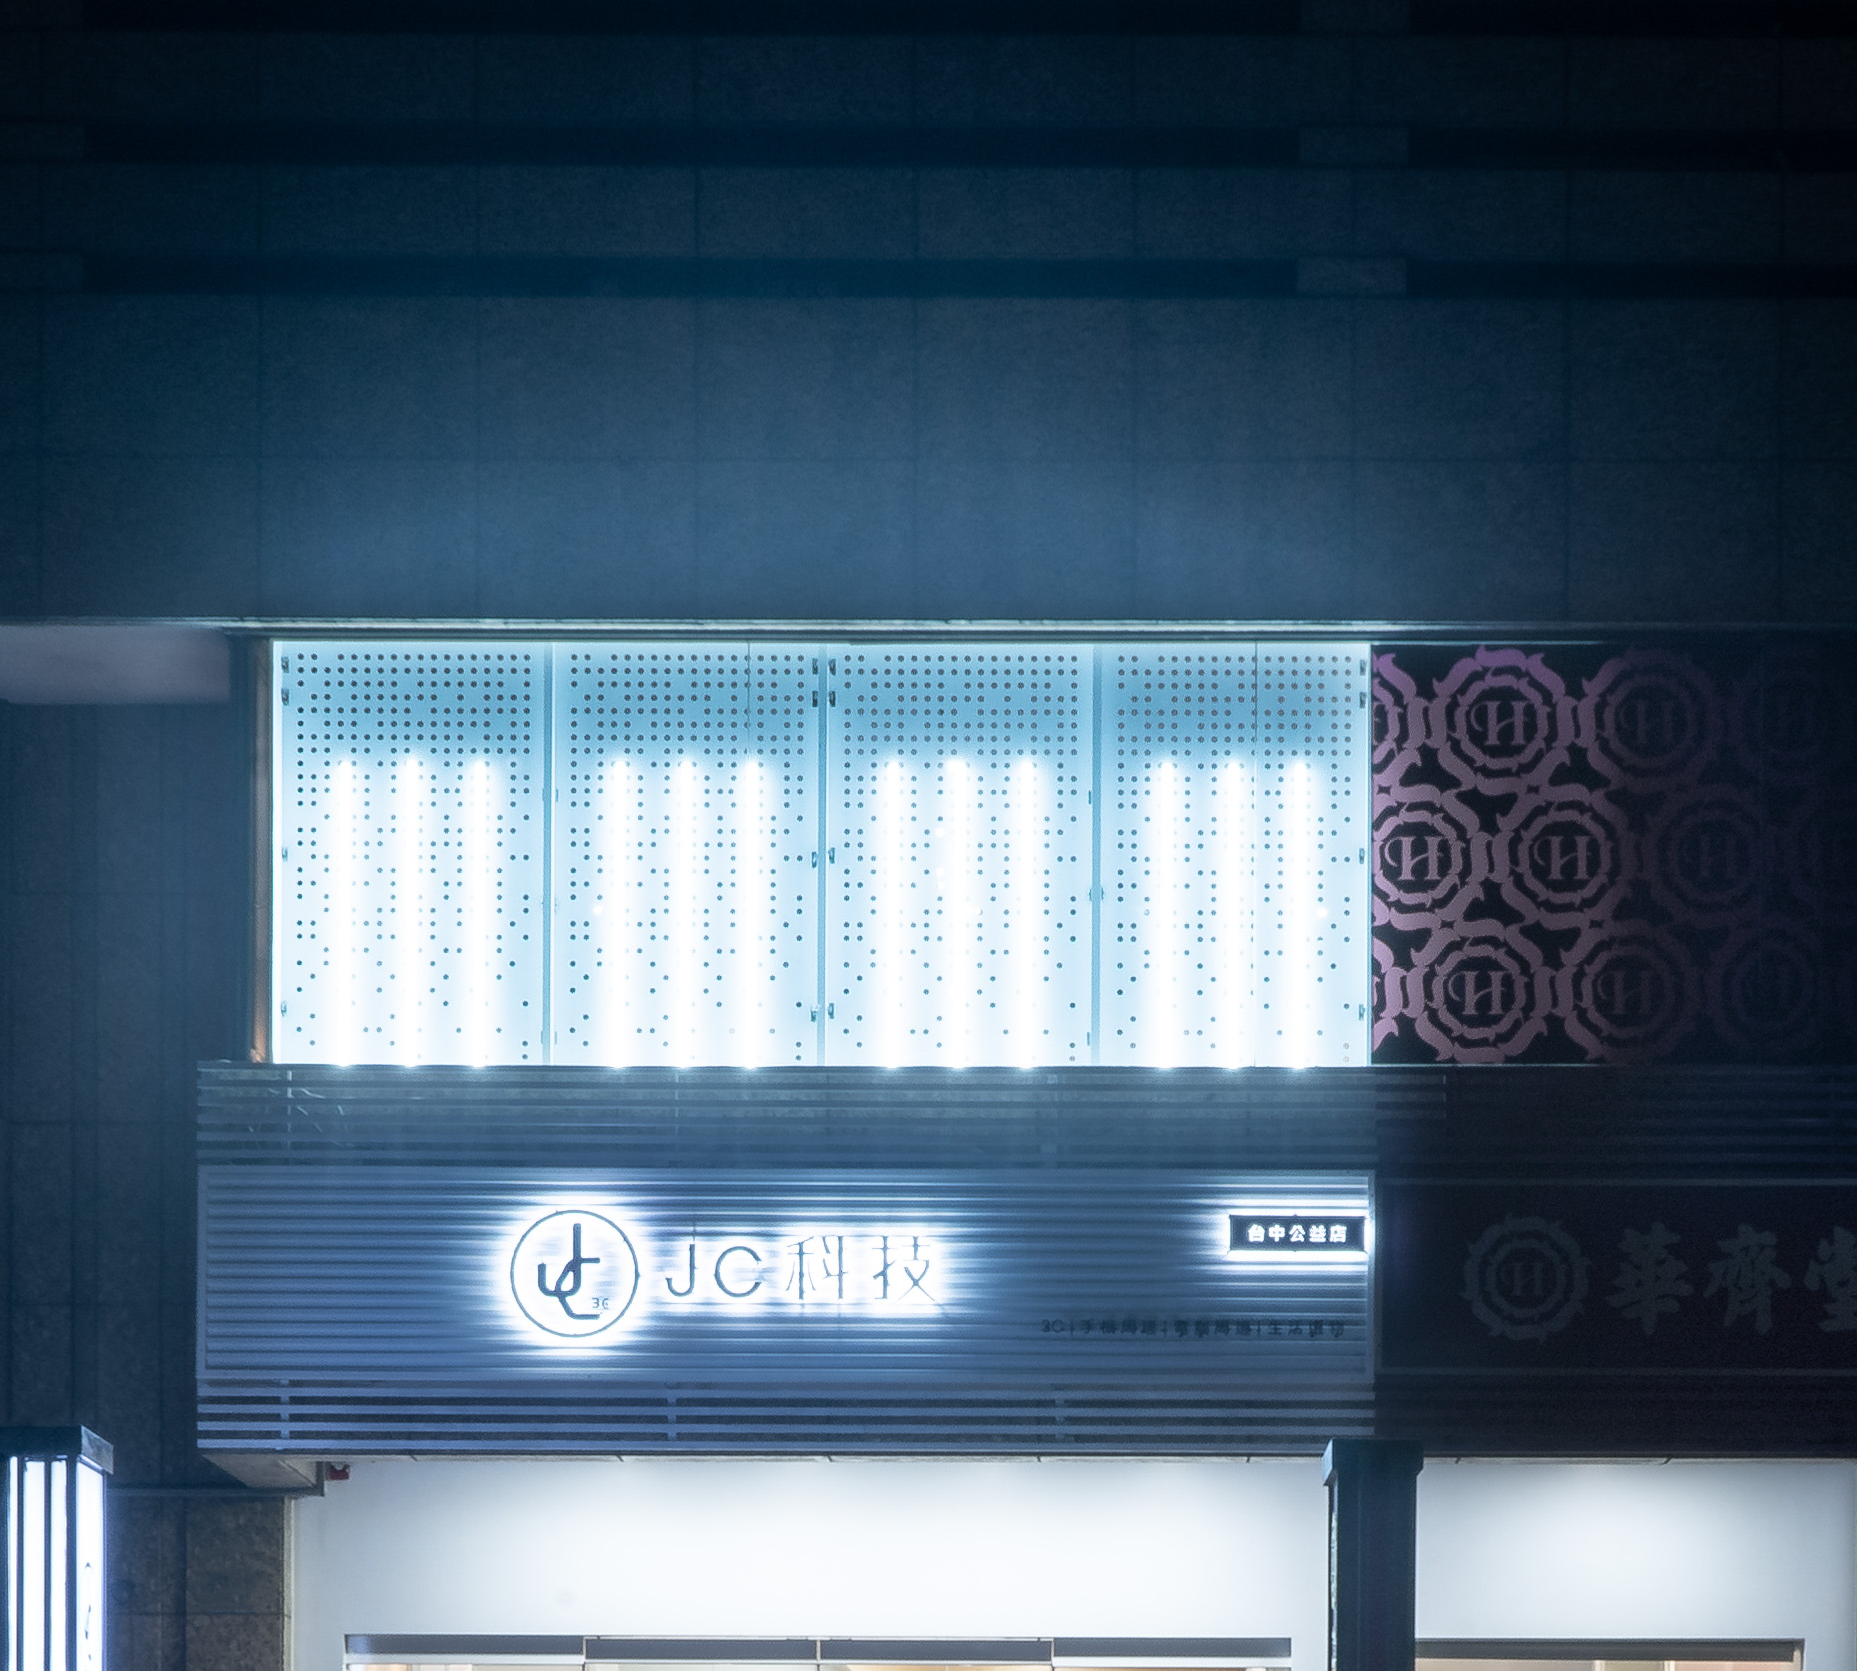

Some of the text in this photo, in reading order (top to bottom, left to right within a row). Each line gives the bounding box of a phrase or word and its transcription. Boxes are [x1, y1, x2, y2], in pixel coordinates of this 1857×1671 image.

[1247, 1223, 1348, 1243] 台中公益店
